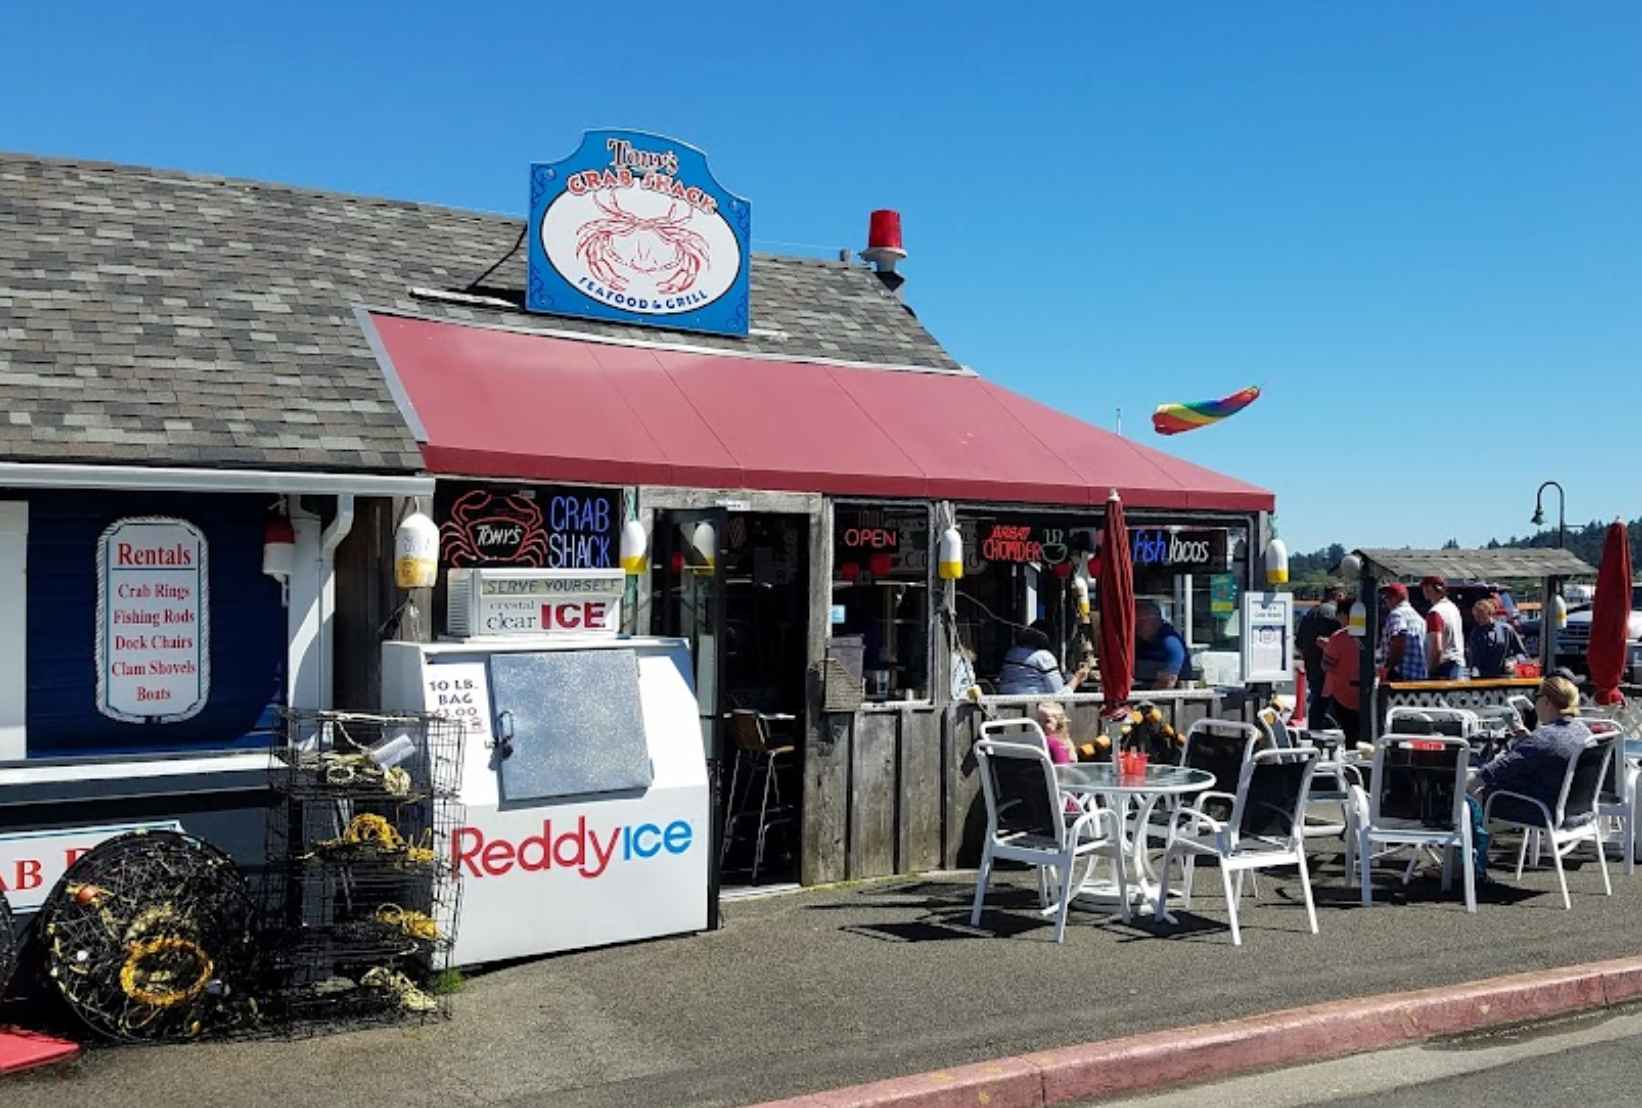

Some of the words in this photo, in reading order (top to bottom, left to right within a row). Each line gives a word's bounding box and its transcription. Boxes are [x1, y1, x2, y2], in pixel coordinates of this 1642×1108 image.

[567, 167, 634, 196] CRAB
[640, 171, 718, 214] SHACK
[578, 276, 649, 309] SEAFOOD
[666, 288, 708, 309] GRILL
[550, 495, 611, 532] CRAB
[844, 528, 897, 548] OPEN
[117, 542, 192, 566] Rentals
[548, 532, 612, 569] SHACK
[982, 538, 1042, 562] CHOWDER
[118, 583, 152, 598] Crab
[154, 583, 190, 600] Rings
[486, 579, 539, 595] SERVE
[544, 577, 618, 593] YOURSELF
[113, 608, 161, 627] Fishing
[163, 608, 195, 624] Rods
[485, 612, 537, 630] clear
[541, 601, 606, 630] ICE
[115, 635, 147, 650] Dock
[151, 634, 193, 649] Chairs
[112, 661, 146, 676] Clam
[148, 659, 197, 674] Shovels
[136, 686, 171, 702] Boats
[429, 679, 449, 692] 10
[438, 692, 473, 705] BAG
